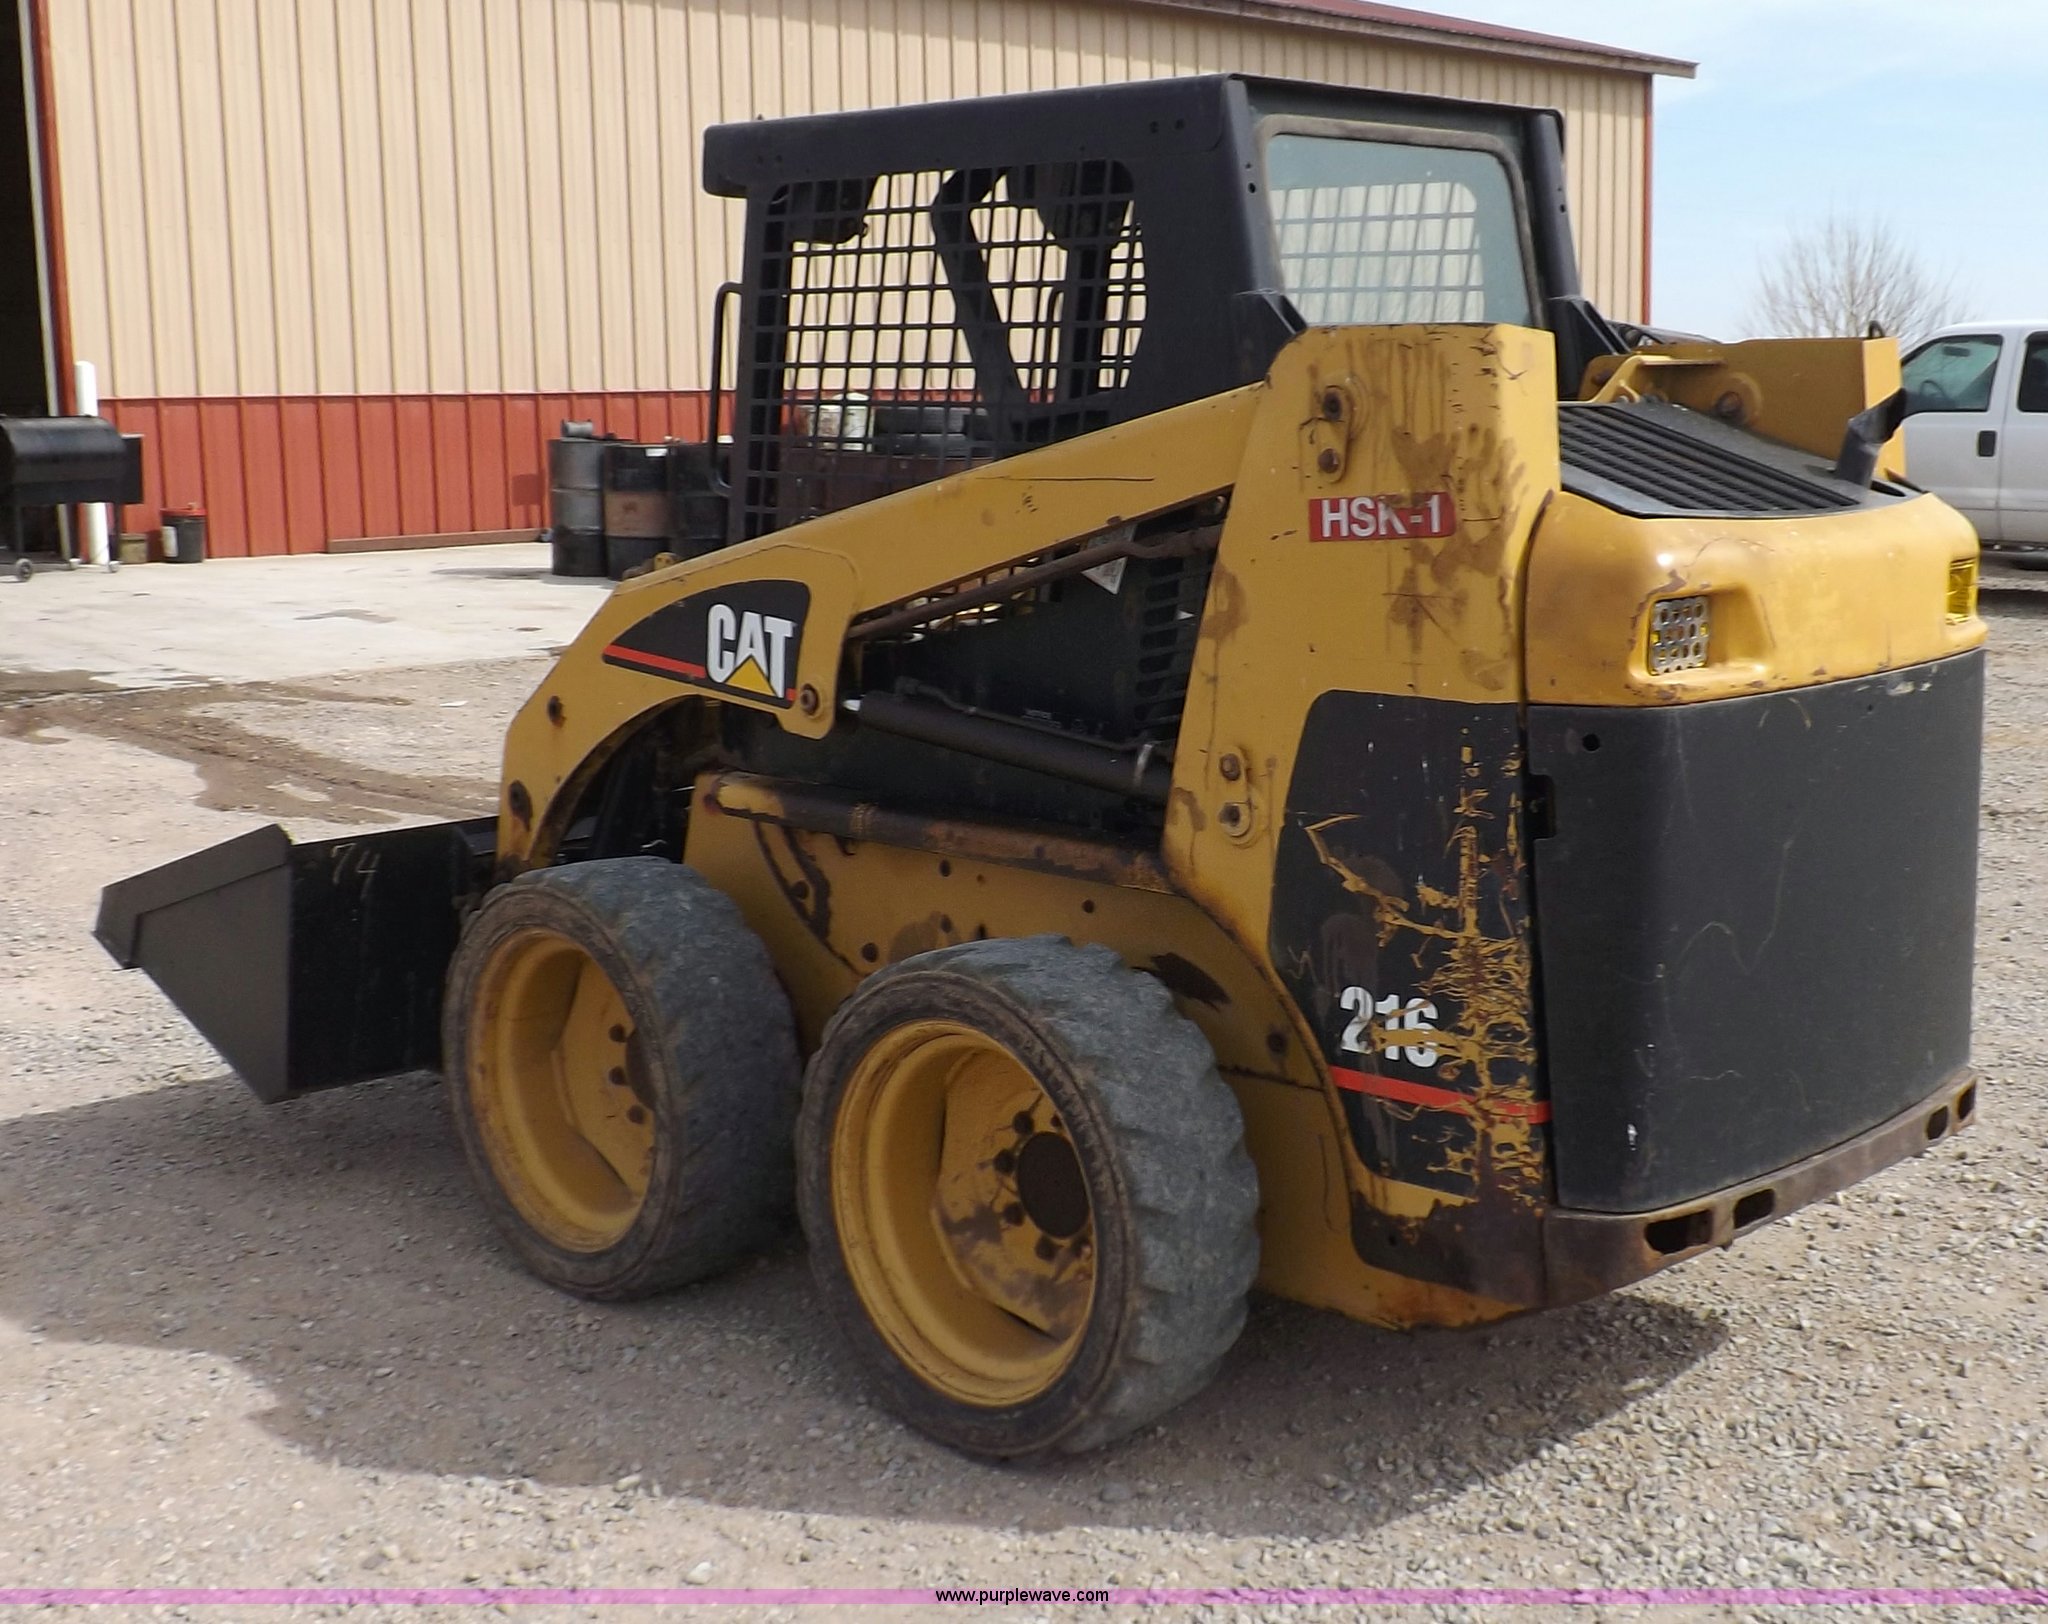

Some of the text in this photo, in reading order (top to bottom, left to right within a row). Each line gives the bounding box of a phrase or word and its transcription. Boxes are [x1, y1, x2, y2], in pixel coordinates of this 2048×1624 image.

[1321, 494, 1441, 538] HSK-1
[707, 603, 797, 698] CAT
[1340, 986, 1438, 1068] 216
